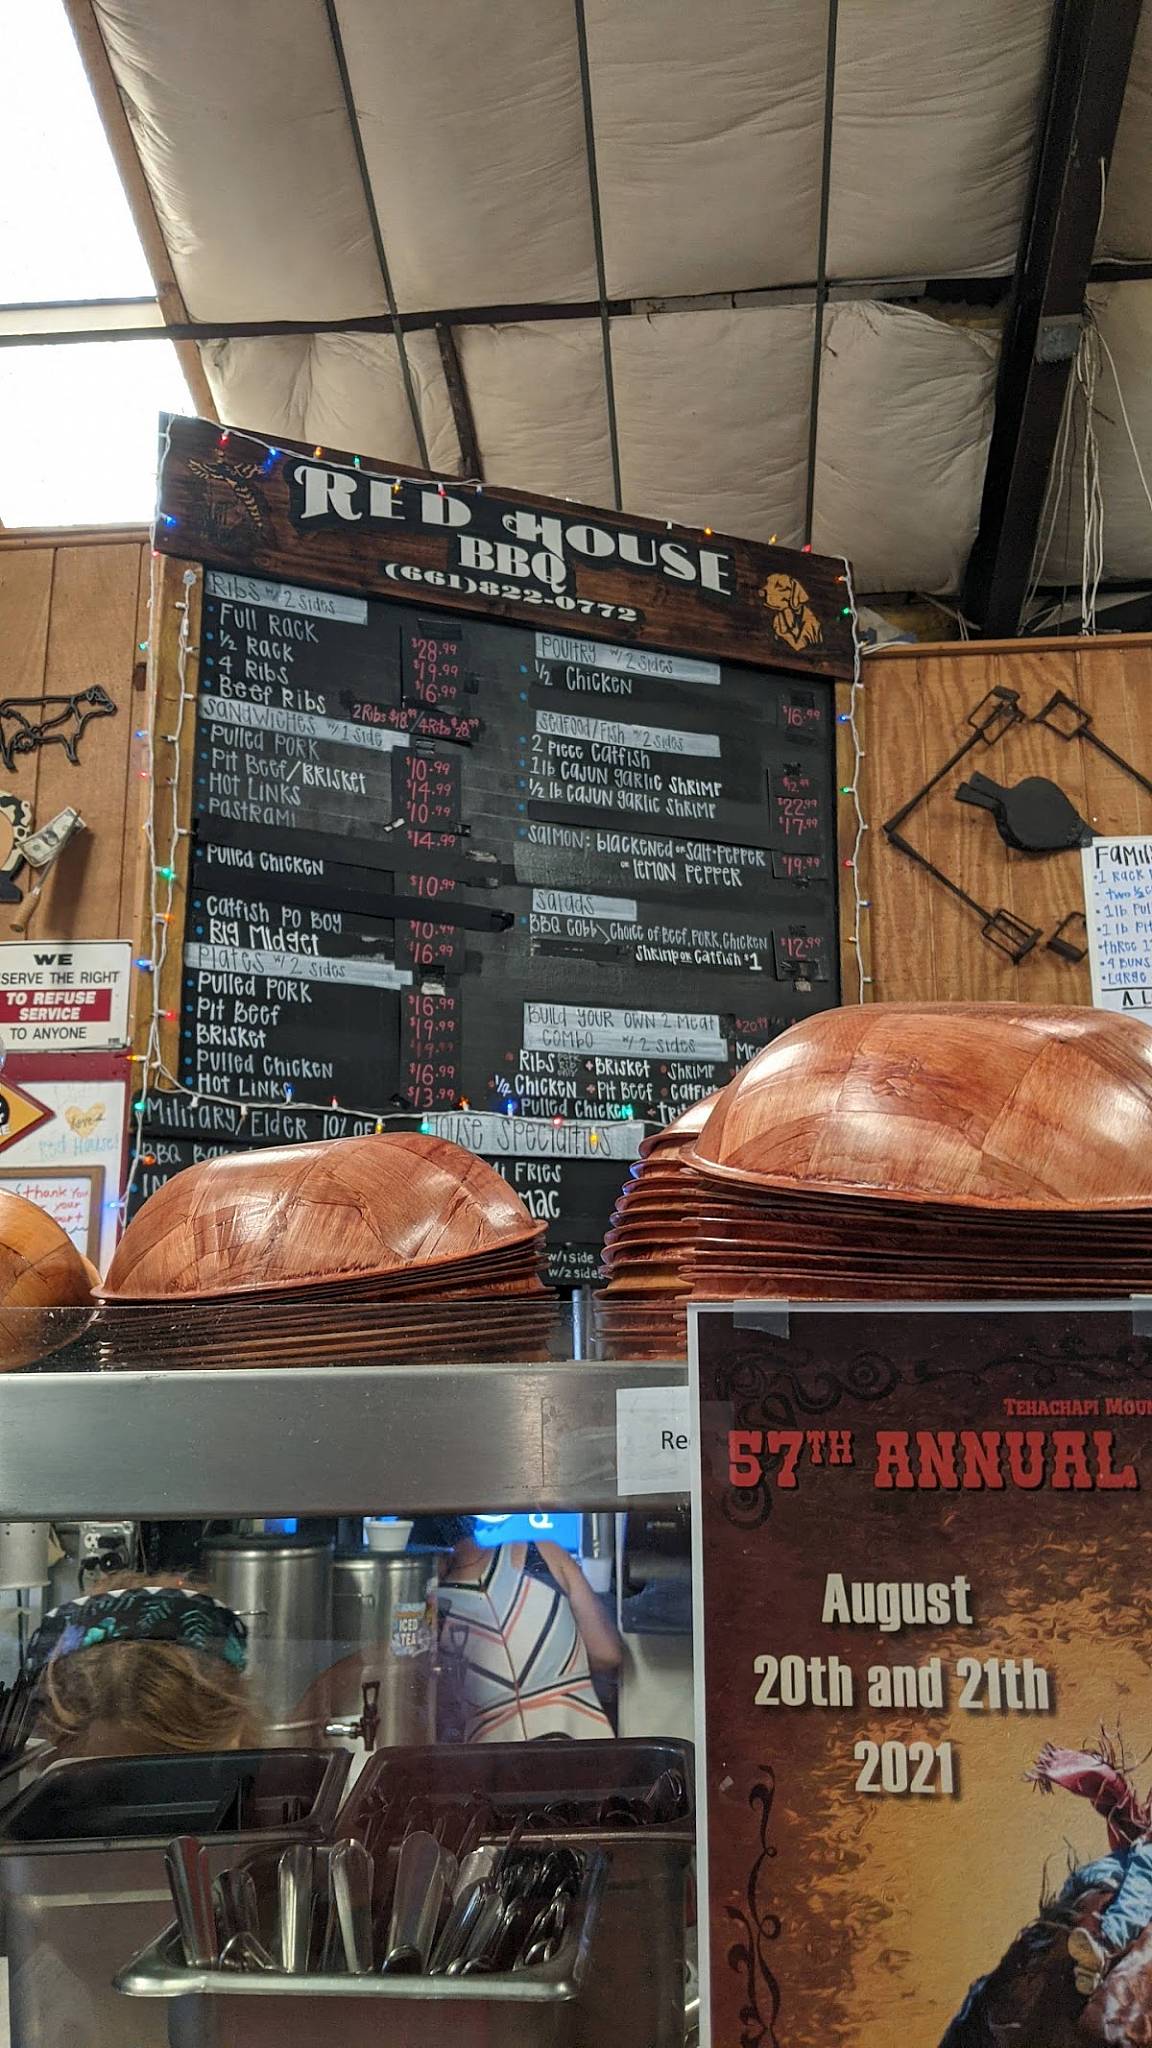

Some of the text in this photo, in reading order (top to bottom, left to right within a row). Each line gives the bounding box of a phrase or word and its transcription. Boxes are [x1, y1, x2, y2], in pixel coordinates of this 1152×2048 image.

[294, 465, 731, 595] RED HOUSE
[457, 534, 567, 594] BBQ
[284, 591, 295, 608] 2
[384, 563, 637, 622] (661)822-0772
[218, 655, 232, 674] 4
[220, 674, 273, 706] Beef
[531, 733, 543, 753] 2
[211, 747, 239, 772] Pit
[406, 756, 450, 781] $10.99
[406, 779, 452, 803] $14.99
[409, 874, 455, 897] $10.99
[529, 913, 562, 934] BBQ
[33, 953, 73, 966] WE
[290, 958, 303, 976] 2
[0, 971, 120, 985] SERVE THE RIGHT
[6, 991, 96, 1006] TO REFUSE
[408, 995, 455, 1017] $16.99
[19, 1007, 81, 1021] SERVICE
[233, 1000, 281, 1026] Beef
[661, 1013, 672, 1029] 2
[10, 1026, 87, 1040] TO ANYONE
[409, 1016, 455, 1041] $19.99
[409, 1062, 455, 1086] $16.99
[407, 1086, 455, 1108] $13.99
[874, 1431, 1139, 1489] ANNUAL
[821, 1573, 973, 1632] August
[754, 1655, 1050, 1711] 20th and 21th
[854, 1741, 954, 1795] 2021
